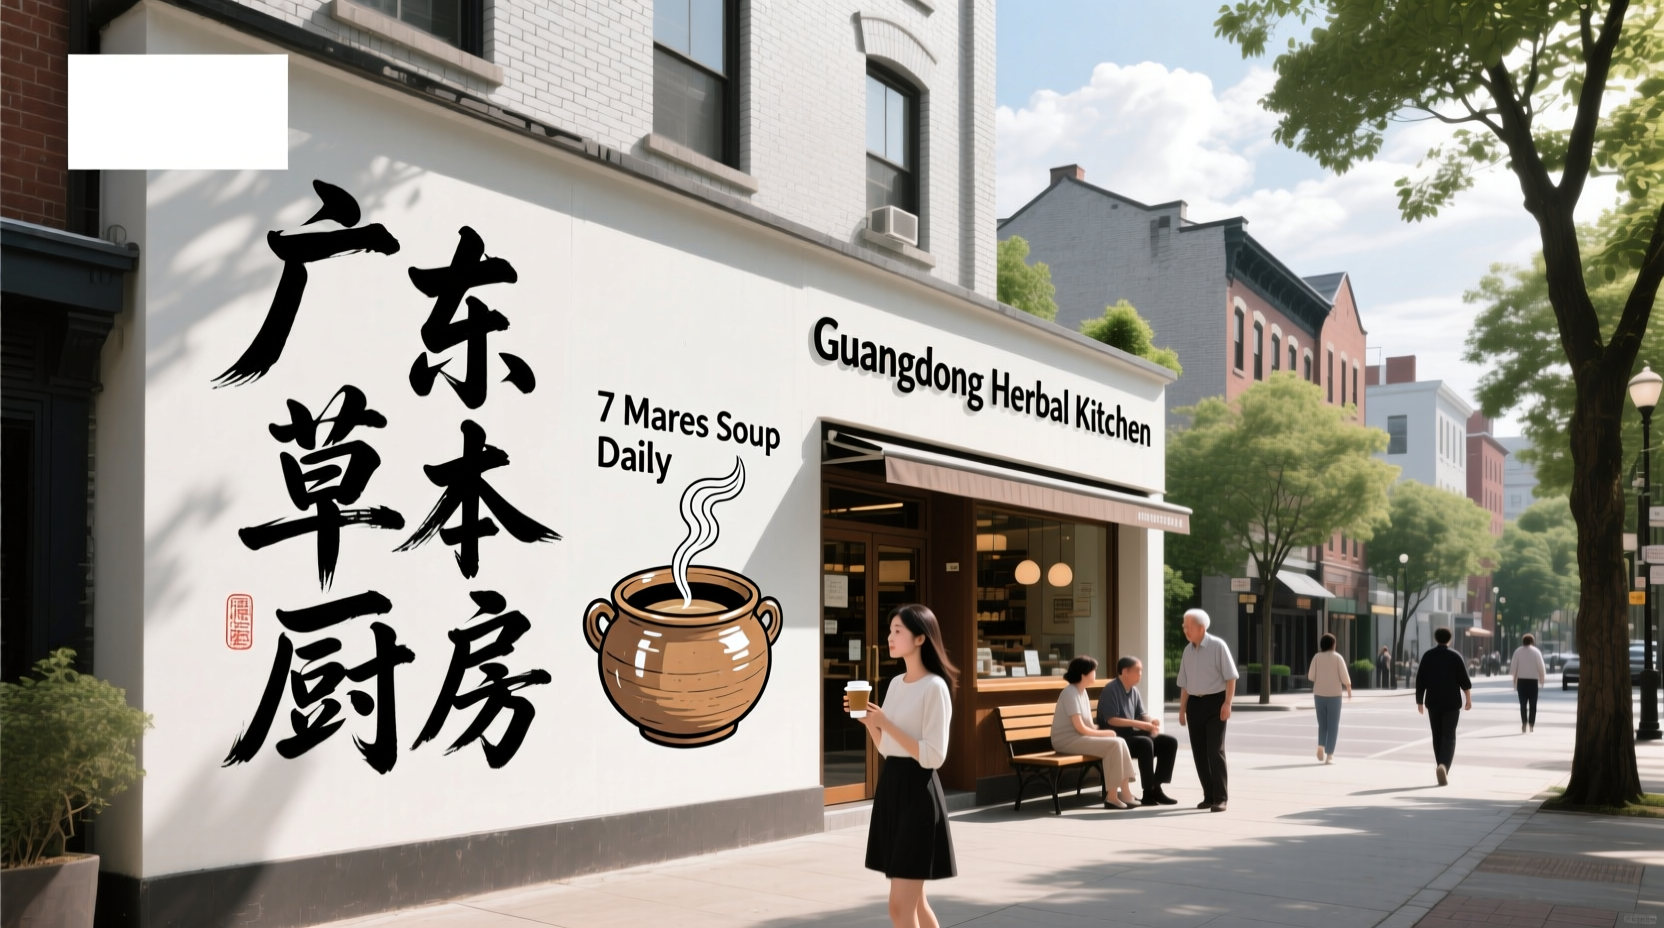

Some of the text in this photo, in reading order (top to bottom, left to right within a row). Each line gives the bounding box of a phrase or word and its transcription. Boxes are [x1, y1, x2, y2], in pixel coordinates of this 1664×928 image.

[210, 179, 536, 410] 广东
[597, 390, 781, 457] 7 Mares Soup
[598, 435, 673, 485] Daily
[813, 316, 1151, 447] Guangdong Herbal Kitchen
[238, 384, 562, 592] 草本
[221, 590, 552, 775] 厨房
